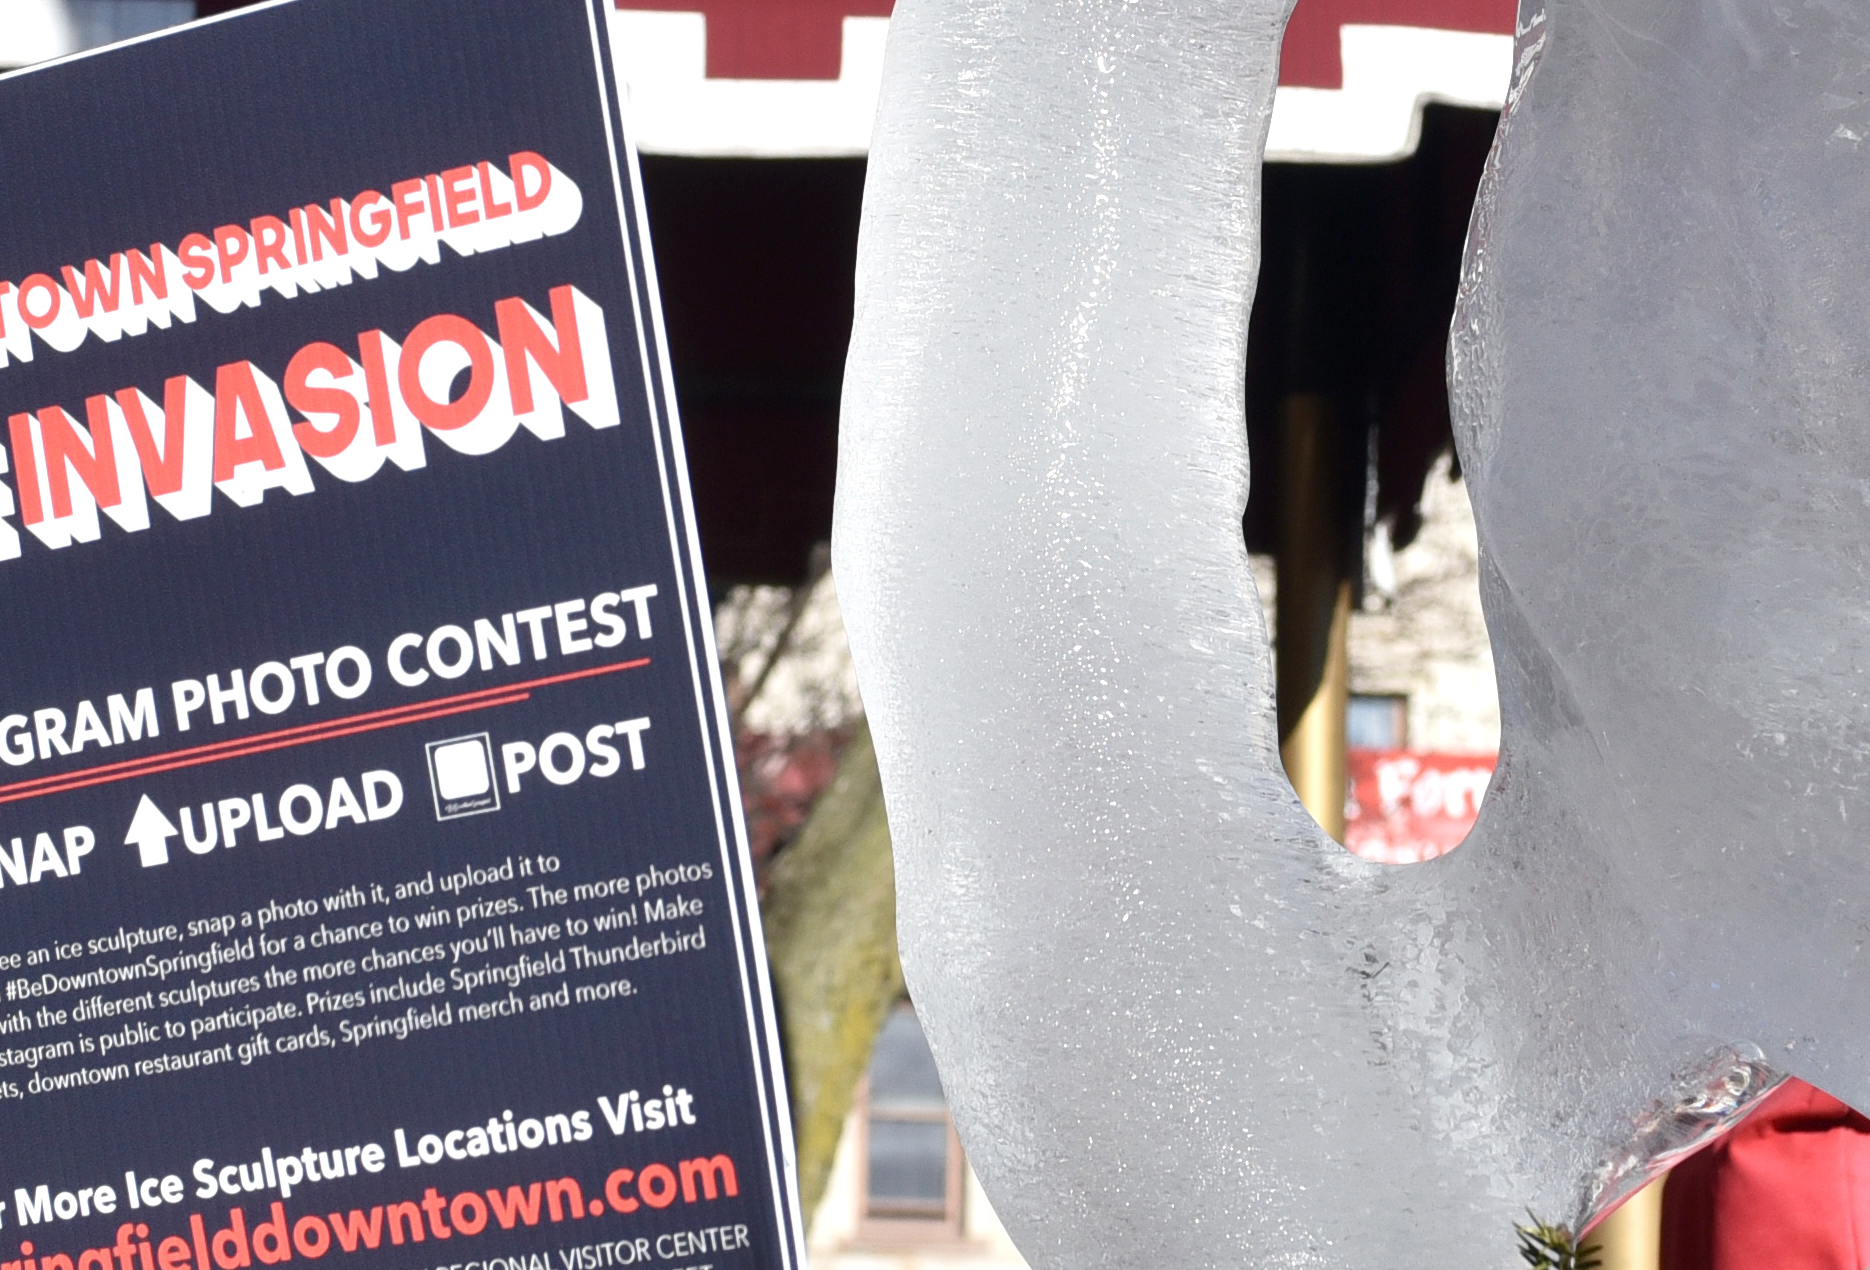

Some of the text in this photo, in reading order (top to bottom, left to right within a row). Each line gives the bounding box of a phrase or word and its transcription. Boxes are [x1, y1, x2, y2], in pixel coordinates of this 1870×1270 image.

[176, 150, 583, 323] SPRINGFIELD
[7, 283, 620, 549] INVASION
[170, 644, 373, 732] PHOTO
[385, 582, 658, 687] CONTEST
[177, 768, 404, 855] UPLOAD
[500, 715, 651, 794] POST
[4, 935, 255, 1001] #BeDowntownSpringfield
[258, 932, 287, 956] for
[292, 934, 306, 951] a
[309, 920, 383, 948] chance
[386, 915, 410, 934] to
[413, 904, 451, 929] win
[455, 896, 524, 929] prizes.
[525, 884, 568, 909] The
[572, 876, 630, 902] more
[635, 861, 713, 897] photos
[26, 947, 50, 966] an
[53, 939, 83, 961] ice
[86, 924, 184, 955] sculpture,
[186, 913, 236, 937] snap
[240, 910, 253, 927] a
[256, 897, 319, 930] photo
[321, 883, 366, 912] with
[369, 882, 390, 905] it,
[394, 870, 434, 900] and
[438, 855, 514, 895] upload
[517, 854, 533, 877] it
[536, 853, 560, 873] to
[35, 1004, 68, 1028] the
[71, 990, 155, 1022] different
[157, 974, 261, 1008] sculptures
[263, 964, 298, 989] the
[301, 958, 356, 982] more
[360, 942, 446, 972] chances
[508, 922, 561, 946] have
[564, 917, 589, 937] to
[592, 902, 638, 932] win!
[642, 894, 703, 923] Make
[26, 1062, 130, 1094] downtown
[133, 1042, 233, 1076] restaurant
[236, 1031, 272, 1066] gift
[274, 1023, 336, 1053] cards,
[338, 1001, 453, 1047] Springfield
[457, 990, 524, 1023] merch
[528, 981, 570, 1011] and
[574, 978, 638, 1003] more.
[77, 1031, 95, 1053] is
[98, 1020, 161, 1055] public
[163, 1019, 186, 1039] to
[189, 1000, 303, 1040] participate.
[305, 989, 366, 1015] Prizes
[368, 970, 446, 1004] include
[449, 948, 566, 995] Springfield
[567, 924, 706, 969] Thunderbird
[13, 1183, 117, 1227] More
[123, 1169, 184, 1210] Ice
[191, 1141, 386, 1200] Sculpture
[392, 1108, 594, 1168] Locations
[595, 1083, 697, 1136] Visit
[655, 1225, 749, 1259] CENTER
